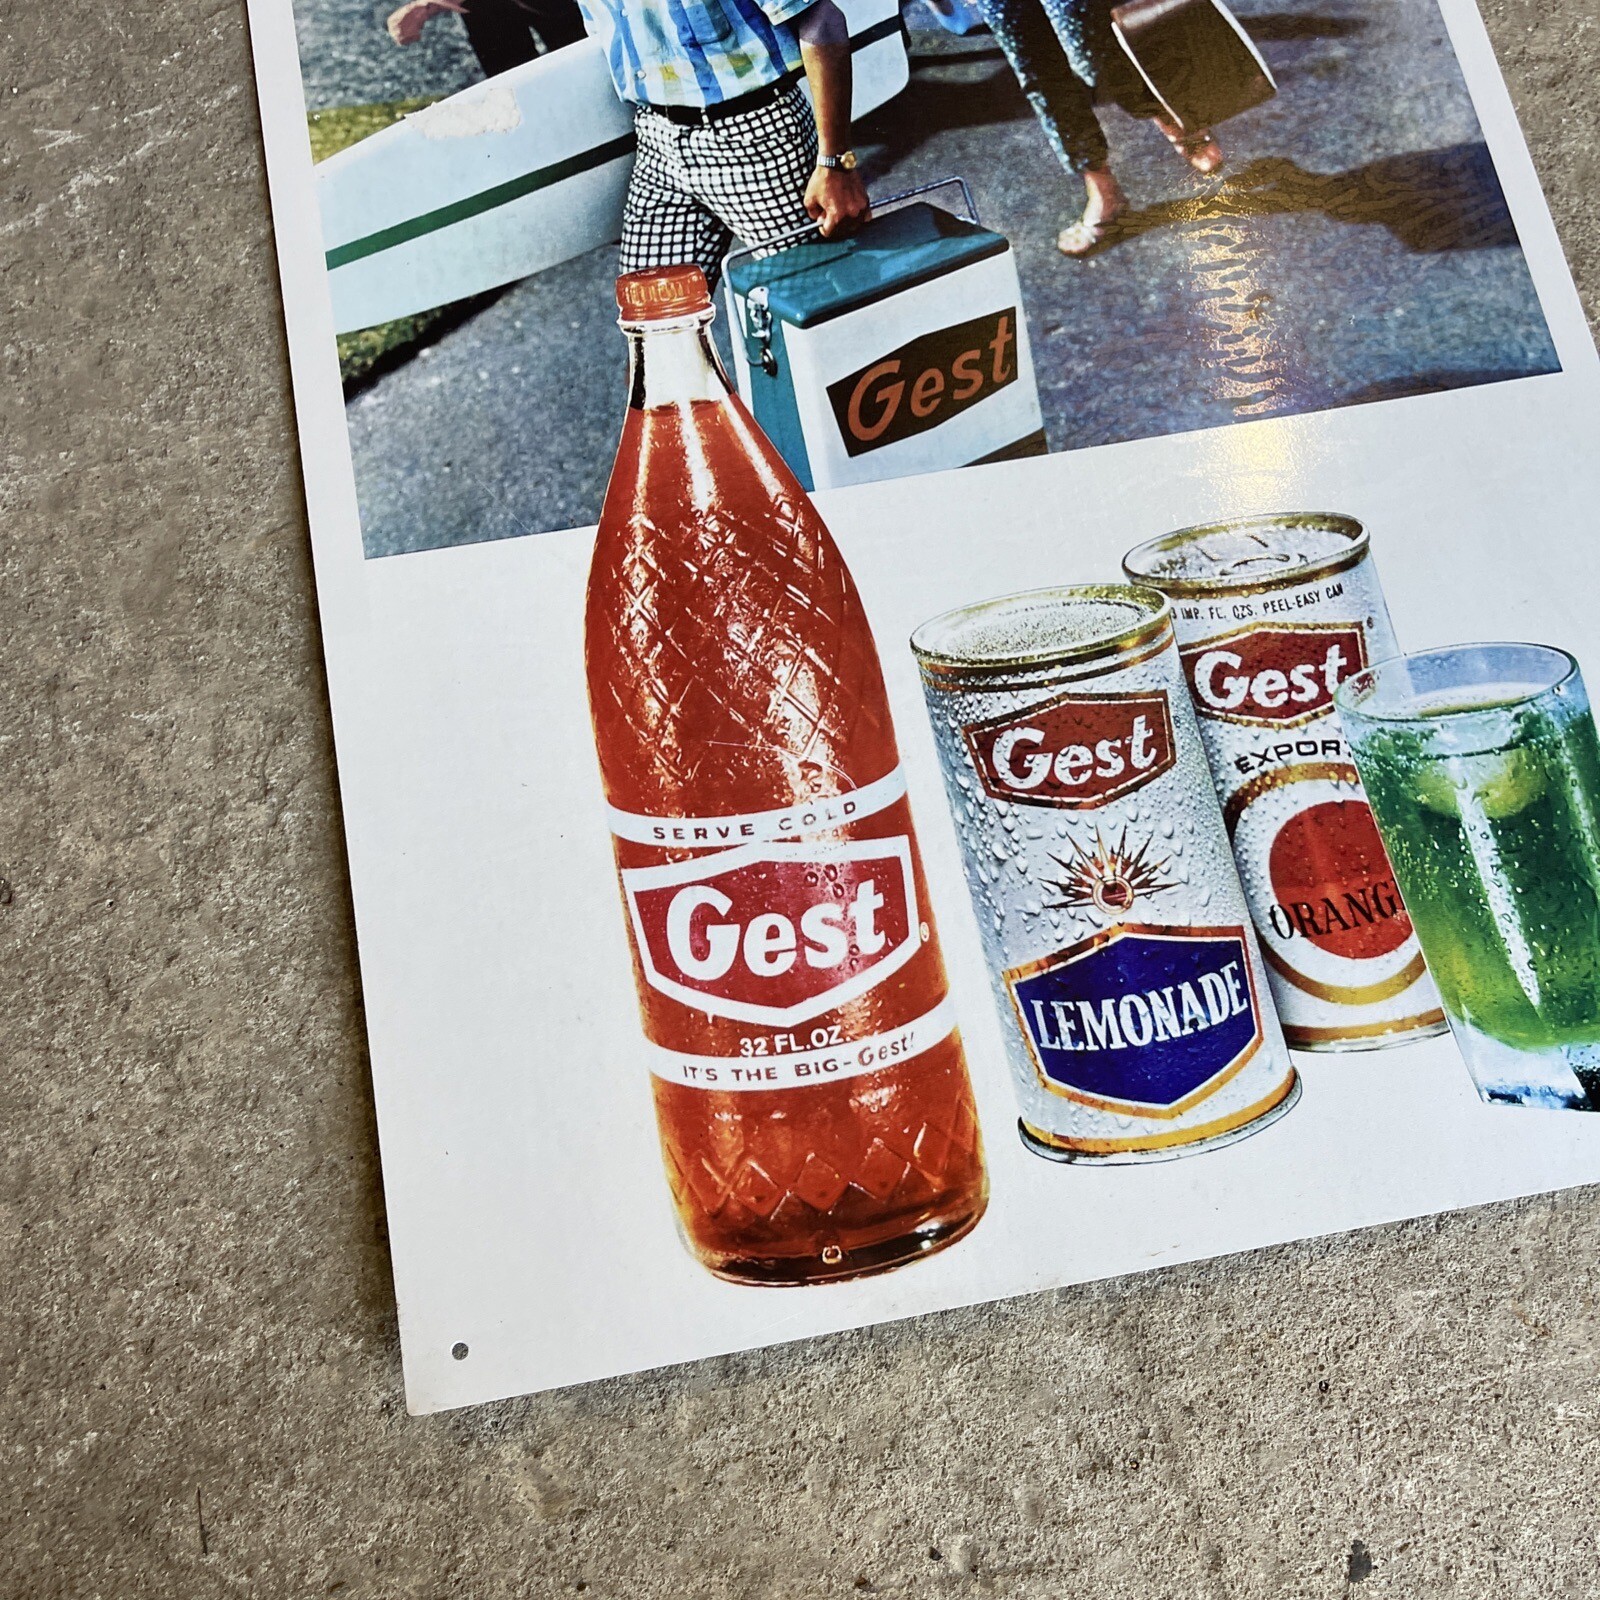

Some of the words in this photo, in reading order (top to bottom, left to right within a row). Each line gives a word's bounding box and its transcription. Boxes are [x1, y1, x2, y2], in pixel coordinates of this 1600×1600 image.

[847, 316, 1013, 442] Gest
[1181, 607, 1204, 619] IMP.
[1263, 590, 1321, 614] PEEL-EASY
[1326, 583, 1344, 600] CAN
[1194, 643, 1348, 709] Gest
[991, 713, 1156, 789] Gest
[1233, 739, 1351, 775] EXPOR
[653, 823, 755, 840] SERVE
[778, 801, 857, 831] COLD
[666, 879, 886, 981] Gest
[1268, 877, 1406, 940] ORANG
[1030, 960, 1250, 1051] LEMONADE
[683, 1065, 718, 1081] IT'S
[731, 1066, 778, 1082] THE
[739, 1036, 767, 1057] 32
